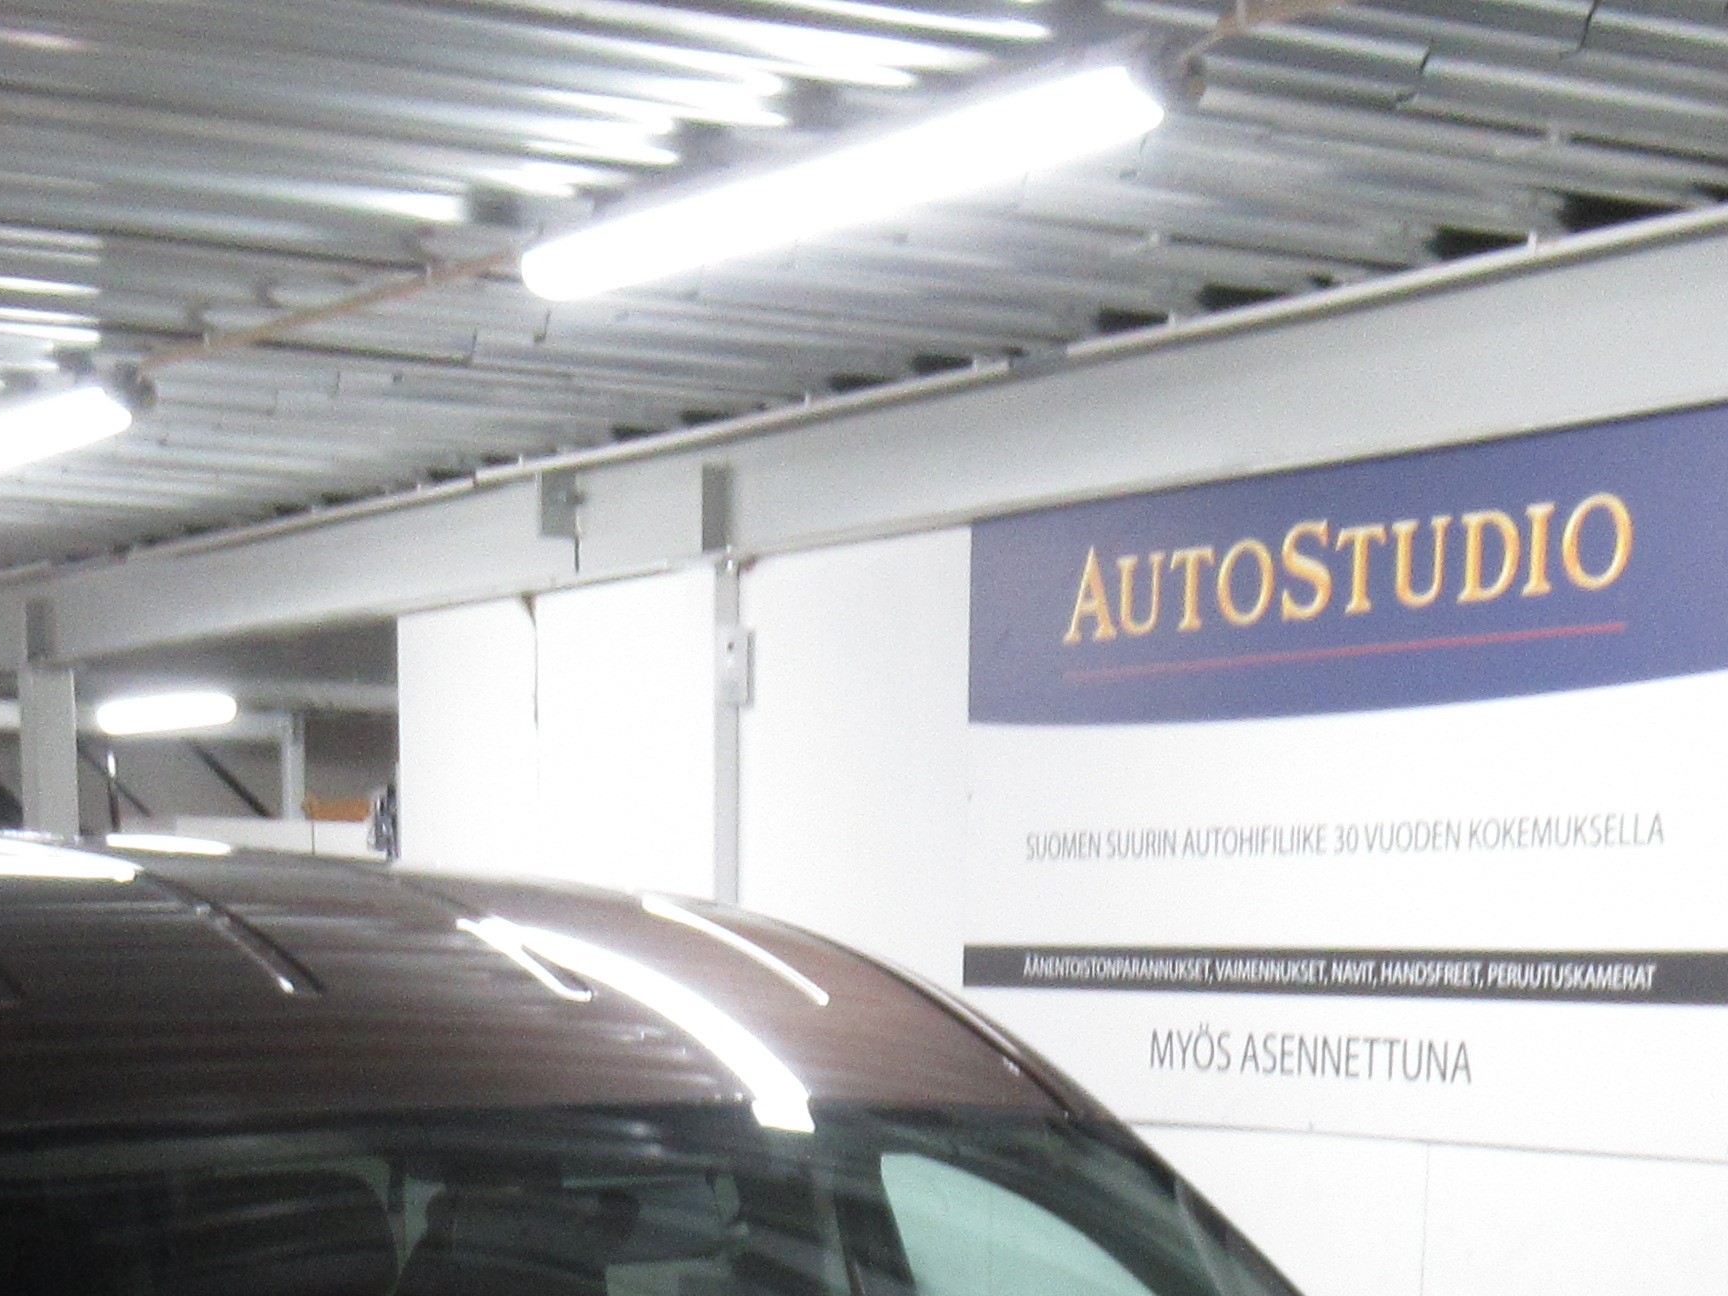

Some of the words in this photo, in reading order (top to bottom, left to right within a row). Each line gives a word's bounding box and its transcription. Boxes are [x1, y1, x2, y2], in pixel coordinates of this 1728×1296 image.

[1025, 829, 1102, 862] SUOMEN
[1106, 827, 1177, 860] SUURIN
[1182, 823, 1327, 858] AUTOHIFILIIKE
[1334, 823, 1359, 856] 30
[1363, 819, 1463, 853] VUODEN
[1468, 811, 1665, 851] KOKEMUKSELLA
[1331, 959, 1377, 988] NAVIT,
[1487, 962, 1658, 991] PERUUTUSKAMERAT
[1150, 1022, 1232, 1072] MYÖS
[1240, 1031, 1472, 1084] ASENNETTUNA
